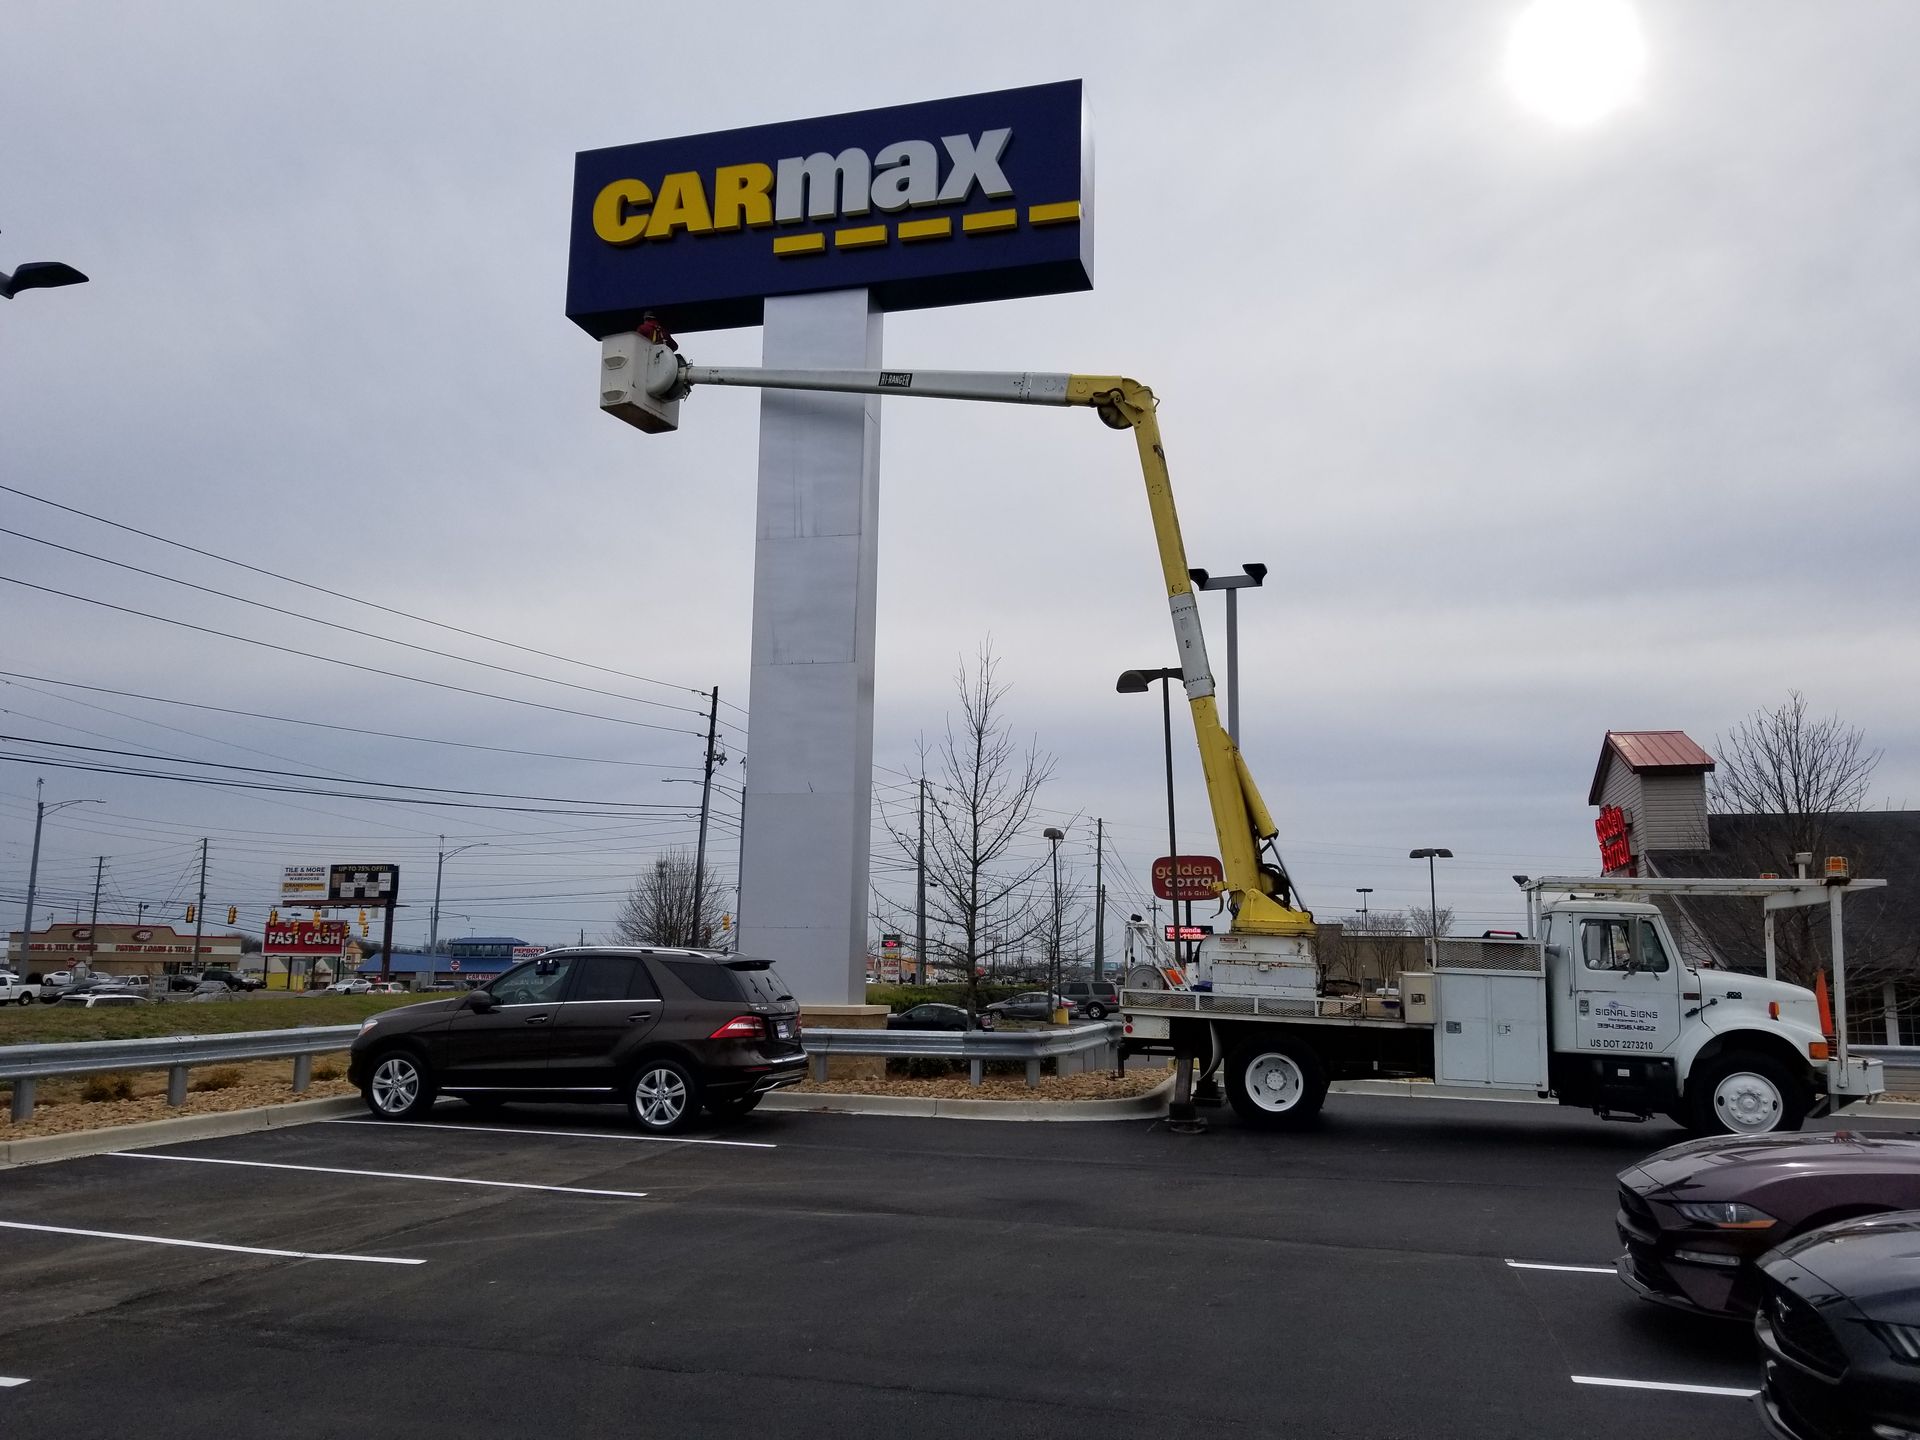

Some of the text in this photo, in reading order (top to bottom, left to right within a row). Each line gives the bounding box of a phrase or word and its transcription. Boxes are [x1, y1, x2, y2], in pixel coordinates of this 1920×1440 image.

[593, 127, 1014, 246] CARmax
[268, 931, 341, 945] FAST CASH
[1595, 1008, 1658, 1019] SIGNAL SIGNS
[1590, 1039, 1653, 1050] US DOT 2273210
